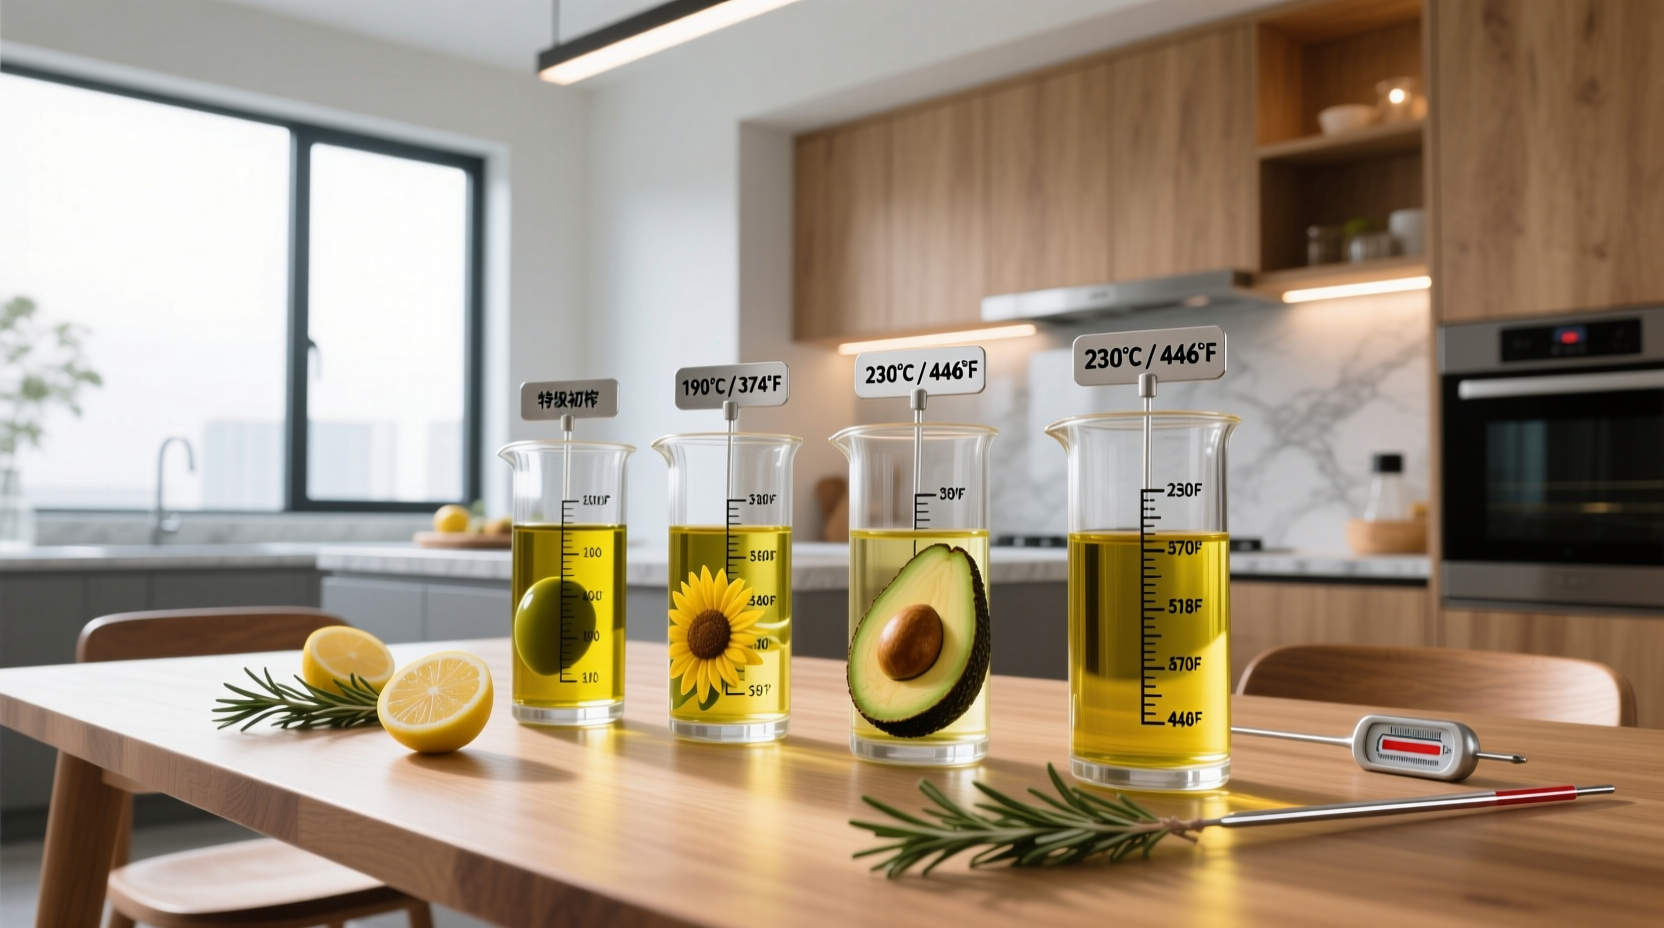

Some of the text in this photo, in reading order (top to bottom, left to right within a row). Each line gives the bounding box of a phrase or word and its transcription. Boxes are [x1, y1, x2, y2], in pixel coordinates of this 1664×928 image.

[1084, 346, 1142, 370] 230°C
[1160, 342, 1217, 365] 446°F
[865, 363, 915, 384] 230°C
[929, 360, 979, 381] 446°F
[682, 377, 726, 397] 190°C
[738, 375, 782, 394] 374°F
[1166, 482, 1203, 497] 230F
